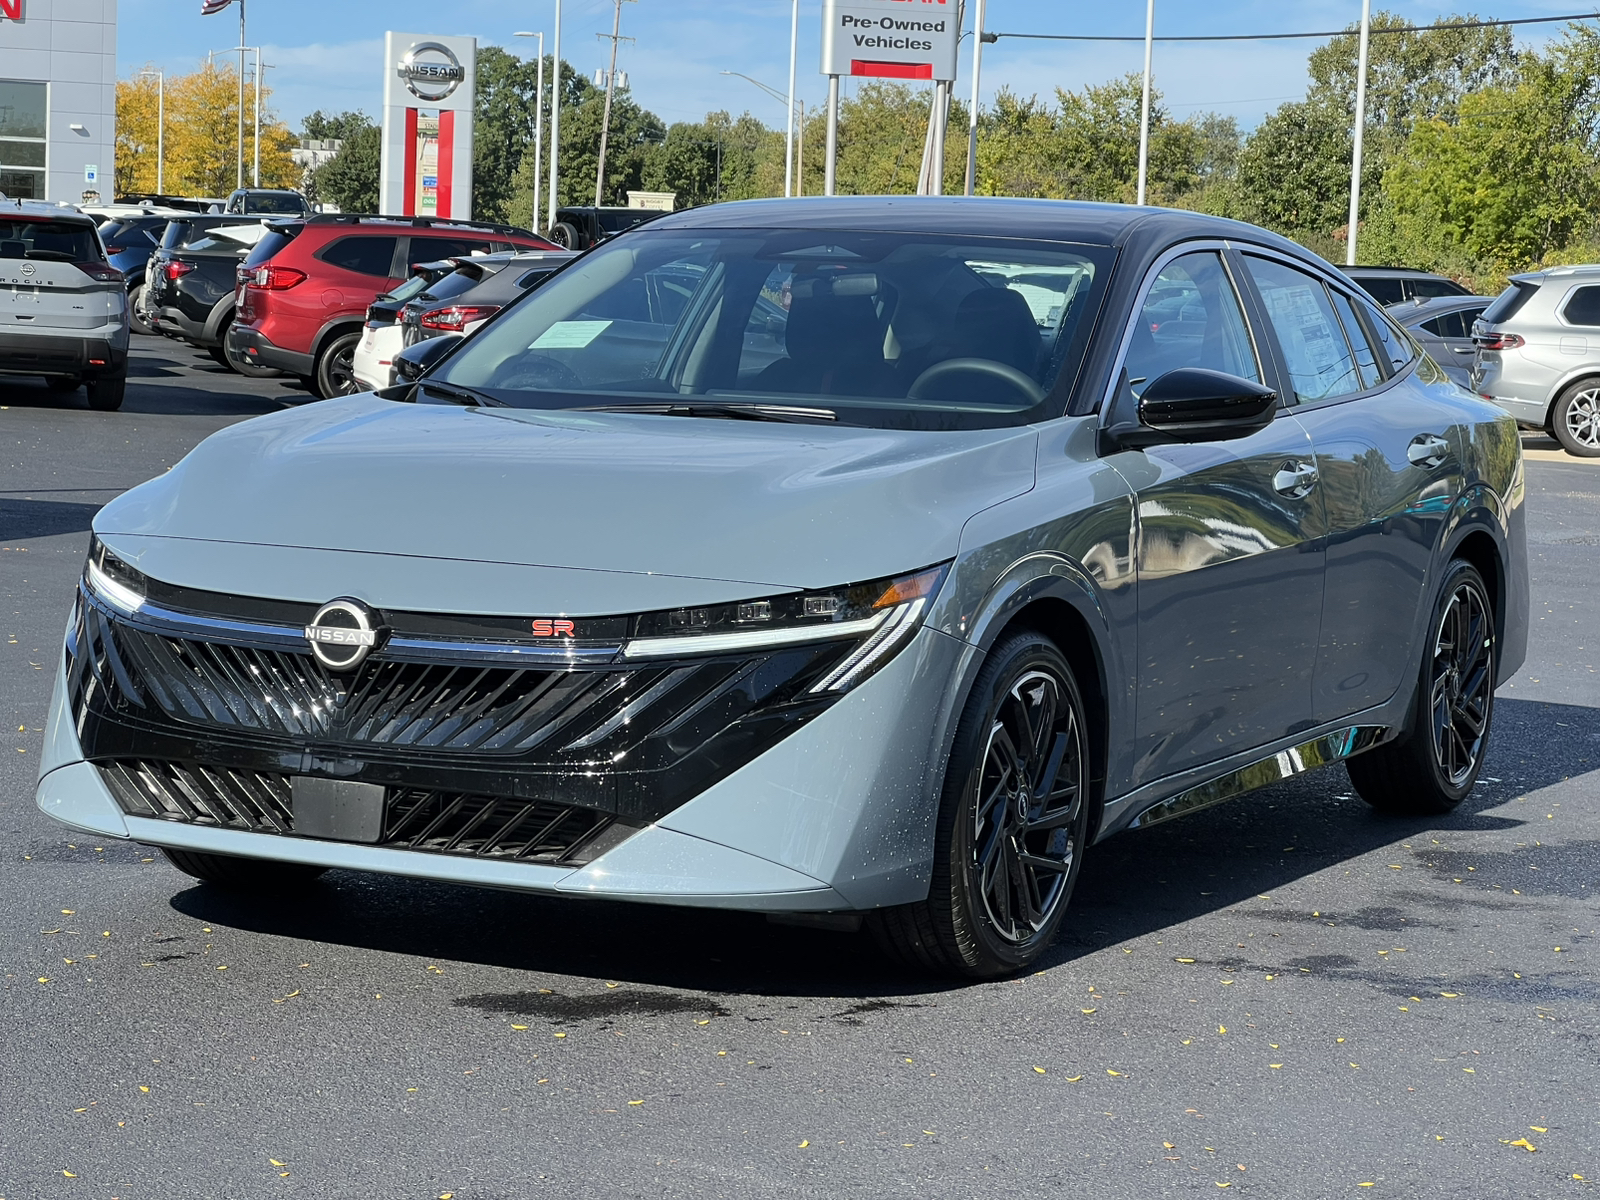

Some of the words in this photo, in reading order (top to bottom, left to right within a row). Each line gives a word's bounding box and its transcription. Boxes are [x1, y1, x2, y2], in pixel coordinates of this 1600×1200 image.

[841, 14, 946, 33] Pre-Owned
[852, 34, 932, 51] Vehicles
[405, 65, 459, 79] NISSAN
[305, 627, 372, 644] NISSAN
[532, 619, 575, 637] SR
